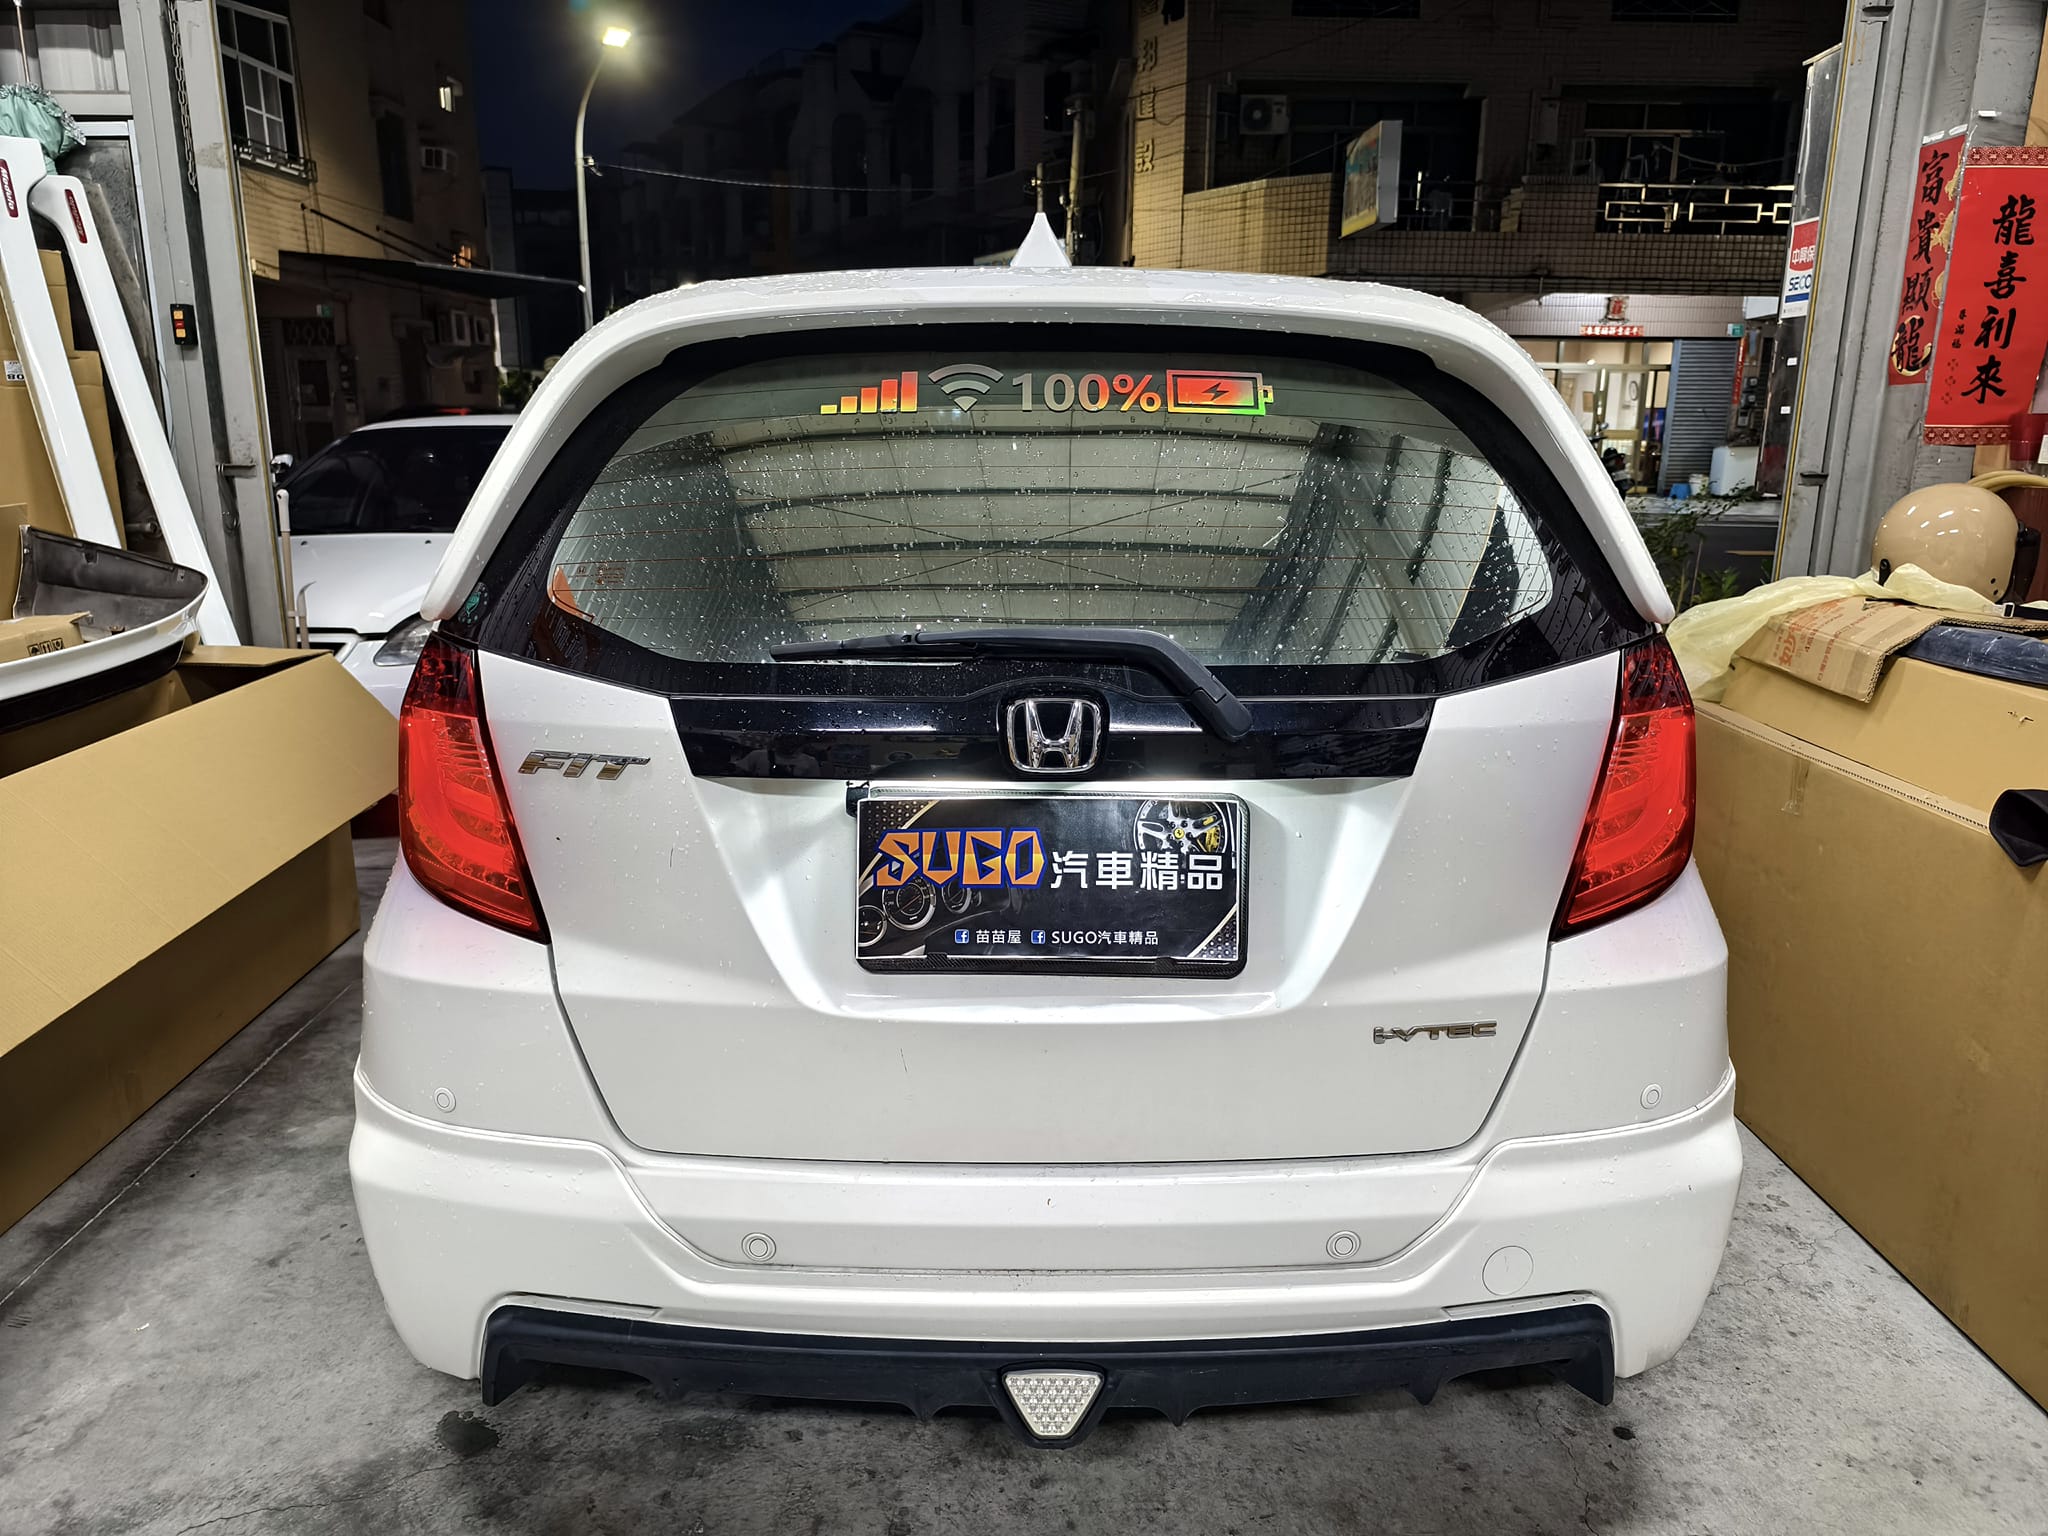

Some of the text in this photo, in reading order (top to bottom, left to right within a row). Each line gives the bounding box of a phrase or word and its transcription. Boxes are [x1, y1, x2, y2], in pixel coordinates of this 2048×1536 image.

[1961, 194, 2036, 404] 龍喜利來
[1012, 372, 1161, 413] 100%
[518, 750, 651, 780] FIT
[873, 827, 1223, 891] SUGO 汽車精品
[976, 930, 1022, 945] 苗苗屋
[1051, 930, 1159, 946] SUGO汽車精品
